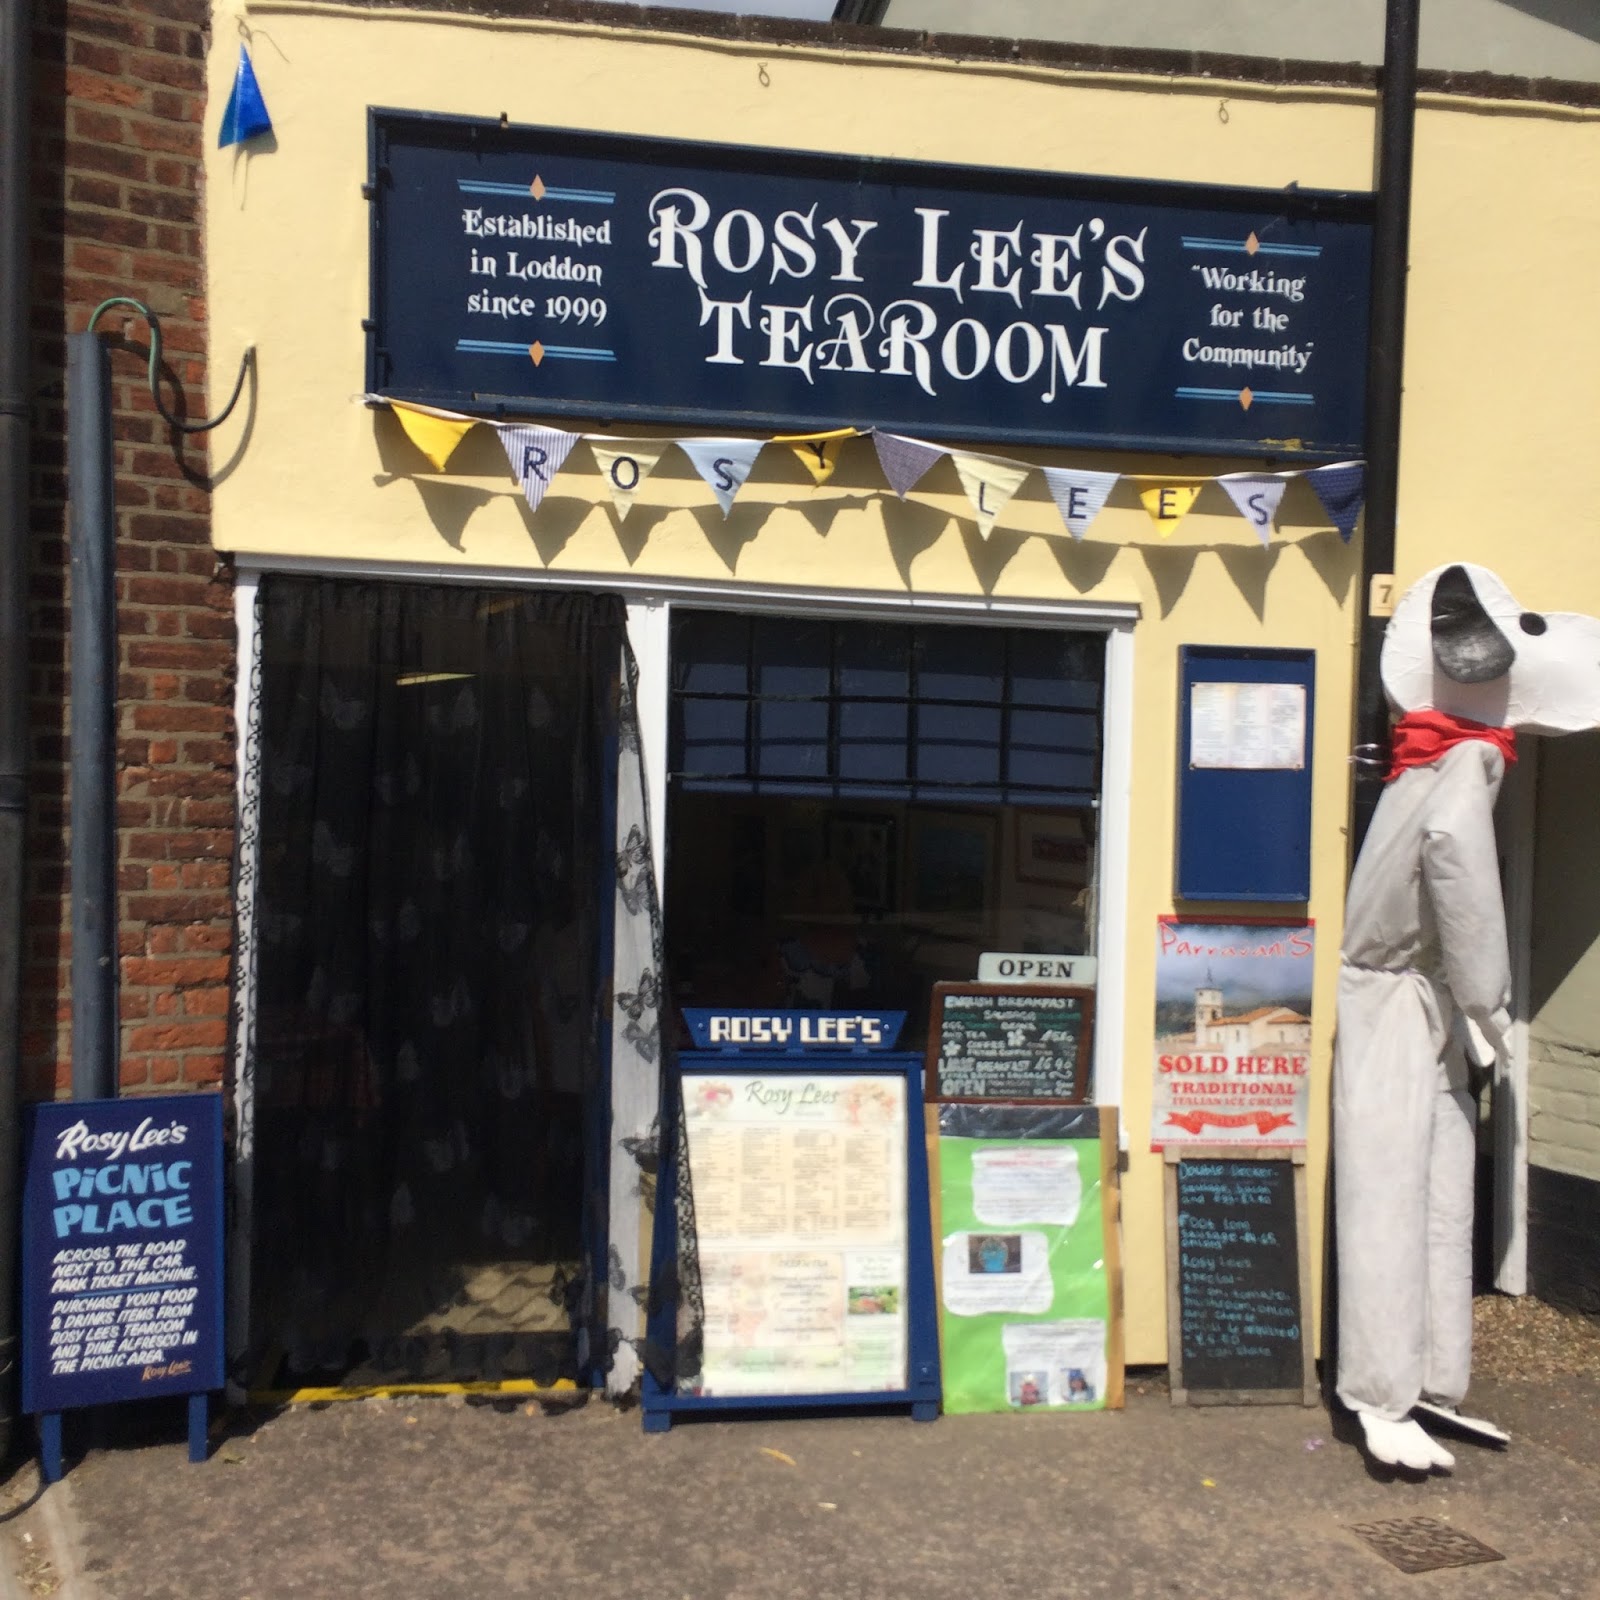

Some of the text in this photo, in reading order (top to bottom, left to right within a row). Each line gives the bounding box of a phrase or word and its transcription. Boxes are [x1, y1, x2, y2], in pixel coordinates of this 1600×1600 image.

[461, 206, 612, 248] Established
[647, 186, 1149, 312] ROSY LEE'S
[469, 247, 603, 288] in Loddon
[467, 288, 608, 328] since 1999
[1209, 302, 1290, 334] for the
[697, 286, 1110, 404] TEAROOM
[1377, 584, 1392, 605] 7
[998, 959, 1075, 978] OPEN
[710, 1016, 881, 1044] ROSY LEE'S
[1158, 1054, 1308, 1076] SOLD HERE
[743, 1080, 793, 1116] Rosy
[1170, 1082, 1297, 1096] TRADITIONAL
[55, 1115, 189, 1161] Rosy Lee's
[52, 1194, 195, 1238] PLACE
[52, 1239, 187, 1265] ACROSS THE ROAD
[51, 1254, 183, 1279] NEXT TO THE CAR
[51, 1266, 199, 1294] PARK TICKET MACHINE.
[51, 1287, 199, 1315] PURCHASE YOUR FOOD
[50, 1303, 194, 1331] & DRINKS ITEMS FROM
[50, 1330, 85, 1346] ROSY
[123, 1318, 186, 1337] TEAROOM
[51, 1330, 199, 1360] AND DINE ALFRESCO IN
[52, 1360, 79, 1375] THE
[79, 1353, 127, 1371] PICNIC
